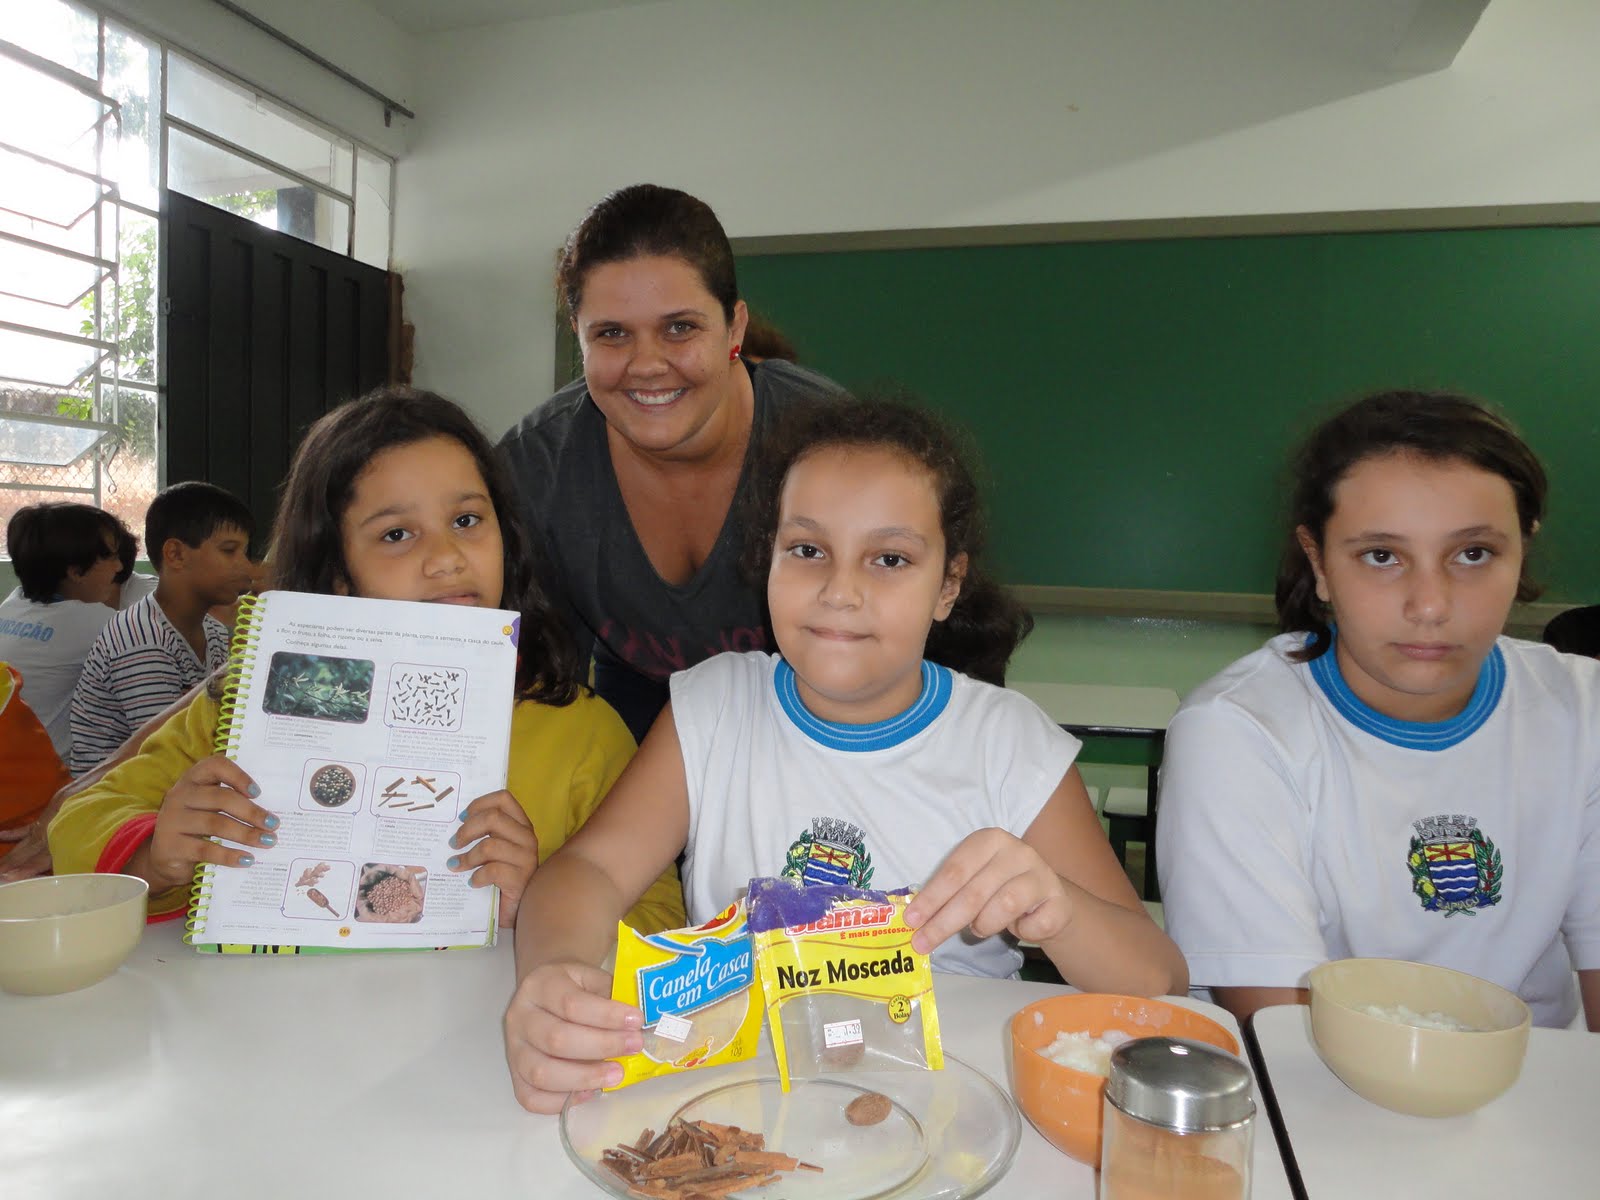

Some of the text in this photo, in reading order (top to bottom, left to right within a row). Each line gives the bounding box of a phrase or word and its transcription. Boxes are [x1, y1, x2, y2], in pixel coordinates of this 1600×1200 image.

[0, 618, 54, 642] UCAÇÃO
[285, 638, 310, 647] Conheça
[789, 904, 893, 934] amar
[848, 929, 870, 939] mais
[650, 955, 711, 1001] Canela
[676, 951, 750, 1010] em Casca
[777, 949, 915, 990] Noz Moscada
[893, 1012, 910, 1020] Bolas
[897, 1001, 905, 1012] 2
